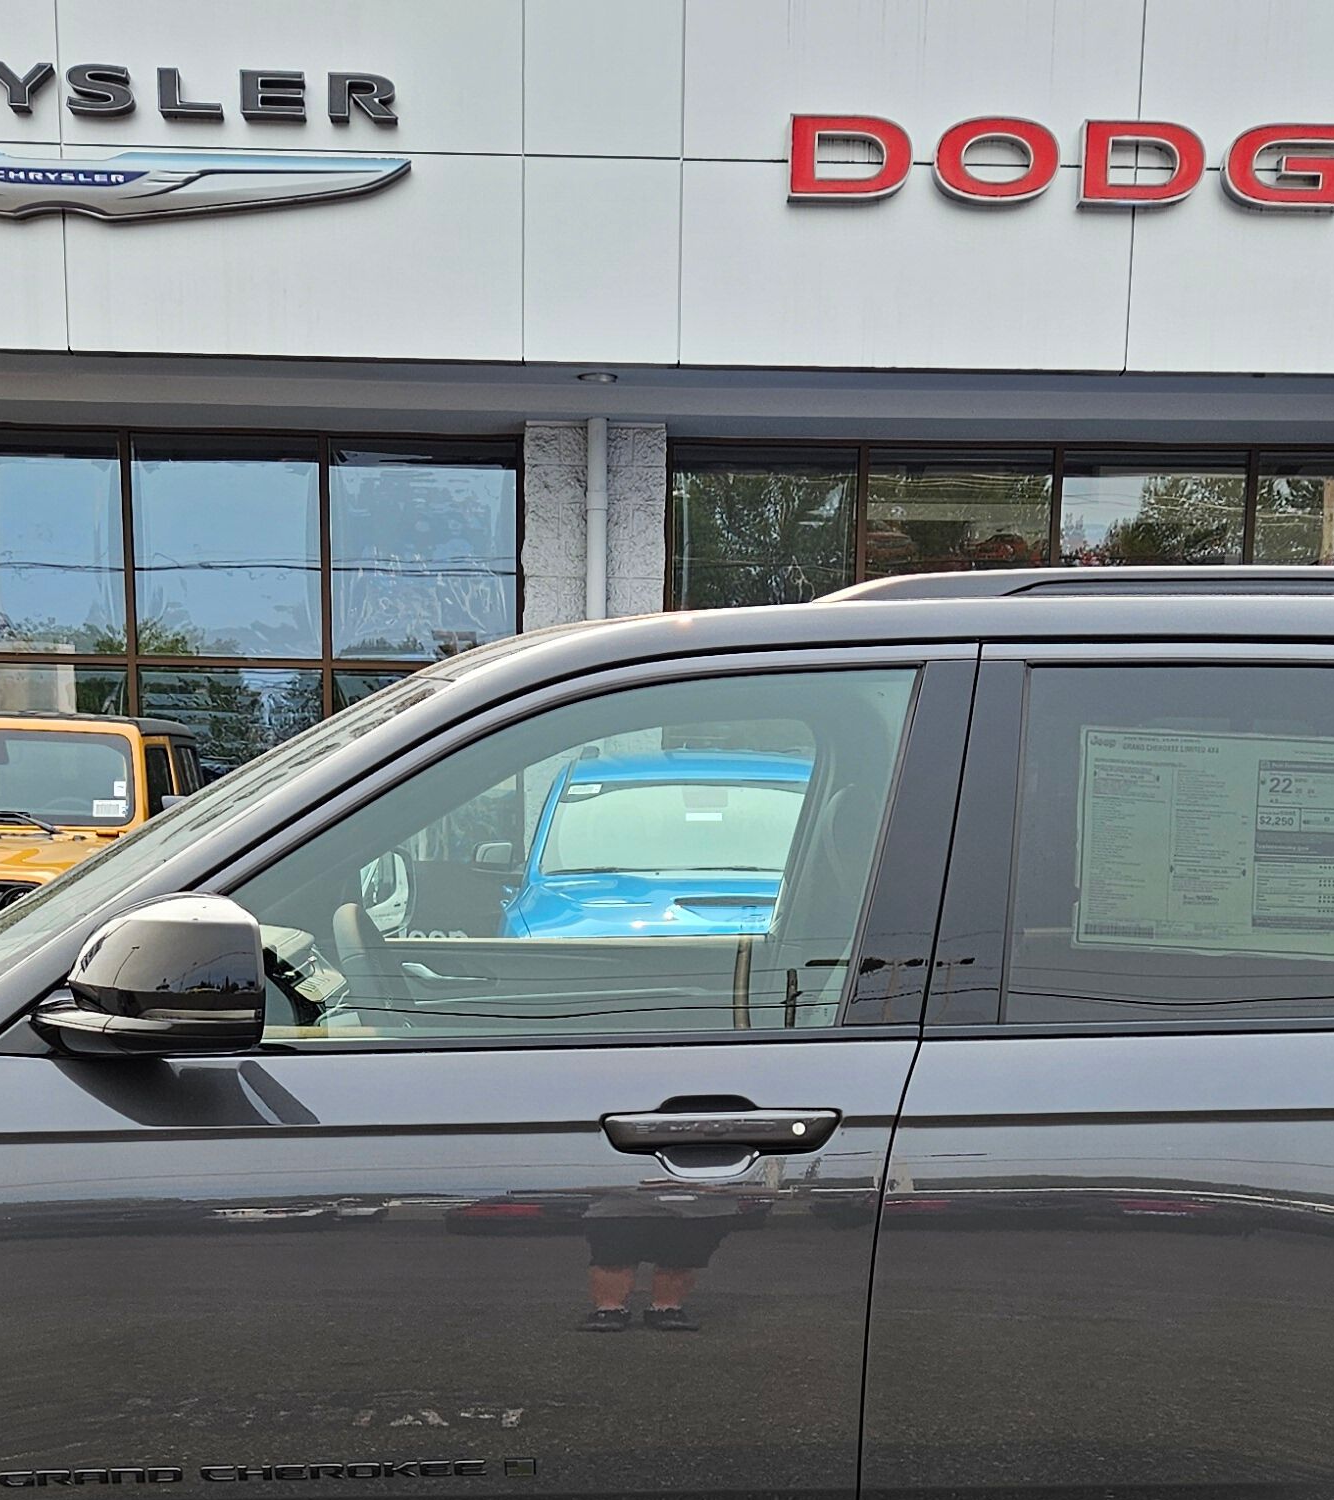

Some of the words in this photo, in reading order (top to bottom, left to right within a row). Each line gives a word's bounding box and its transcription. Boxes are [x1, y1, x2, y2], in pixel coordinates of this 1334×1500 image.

[1269, 777, 1293, 794] 22
[1258, 815, 1294, 827] $2,250
[200, 1458, 487, 1482] CHEROKEE
